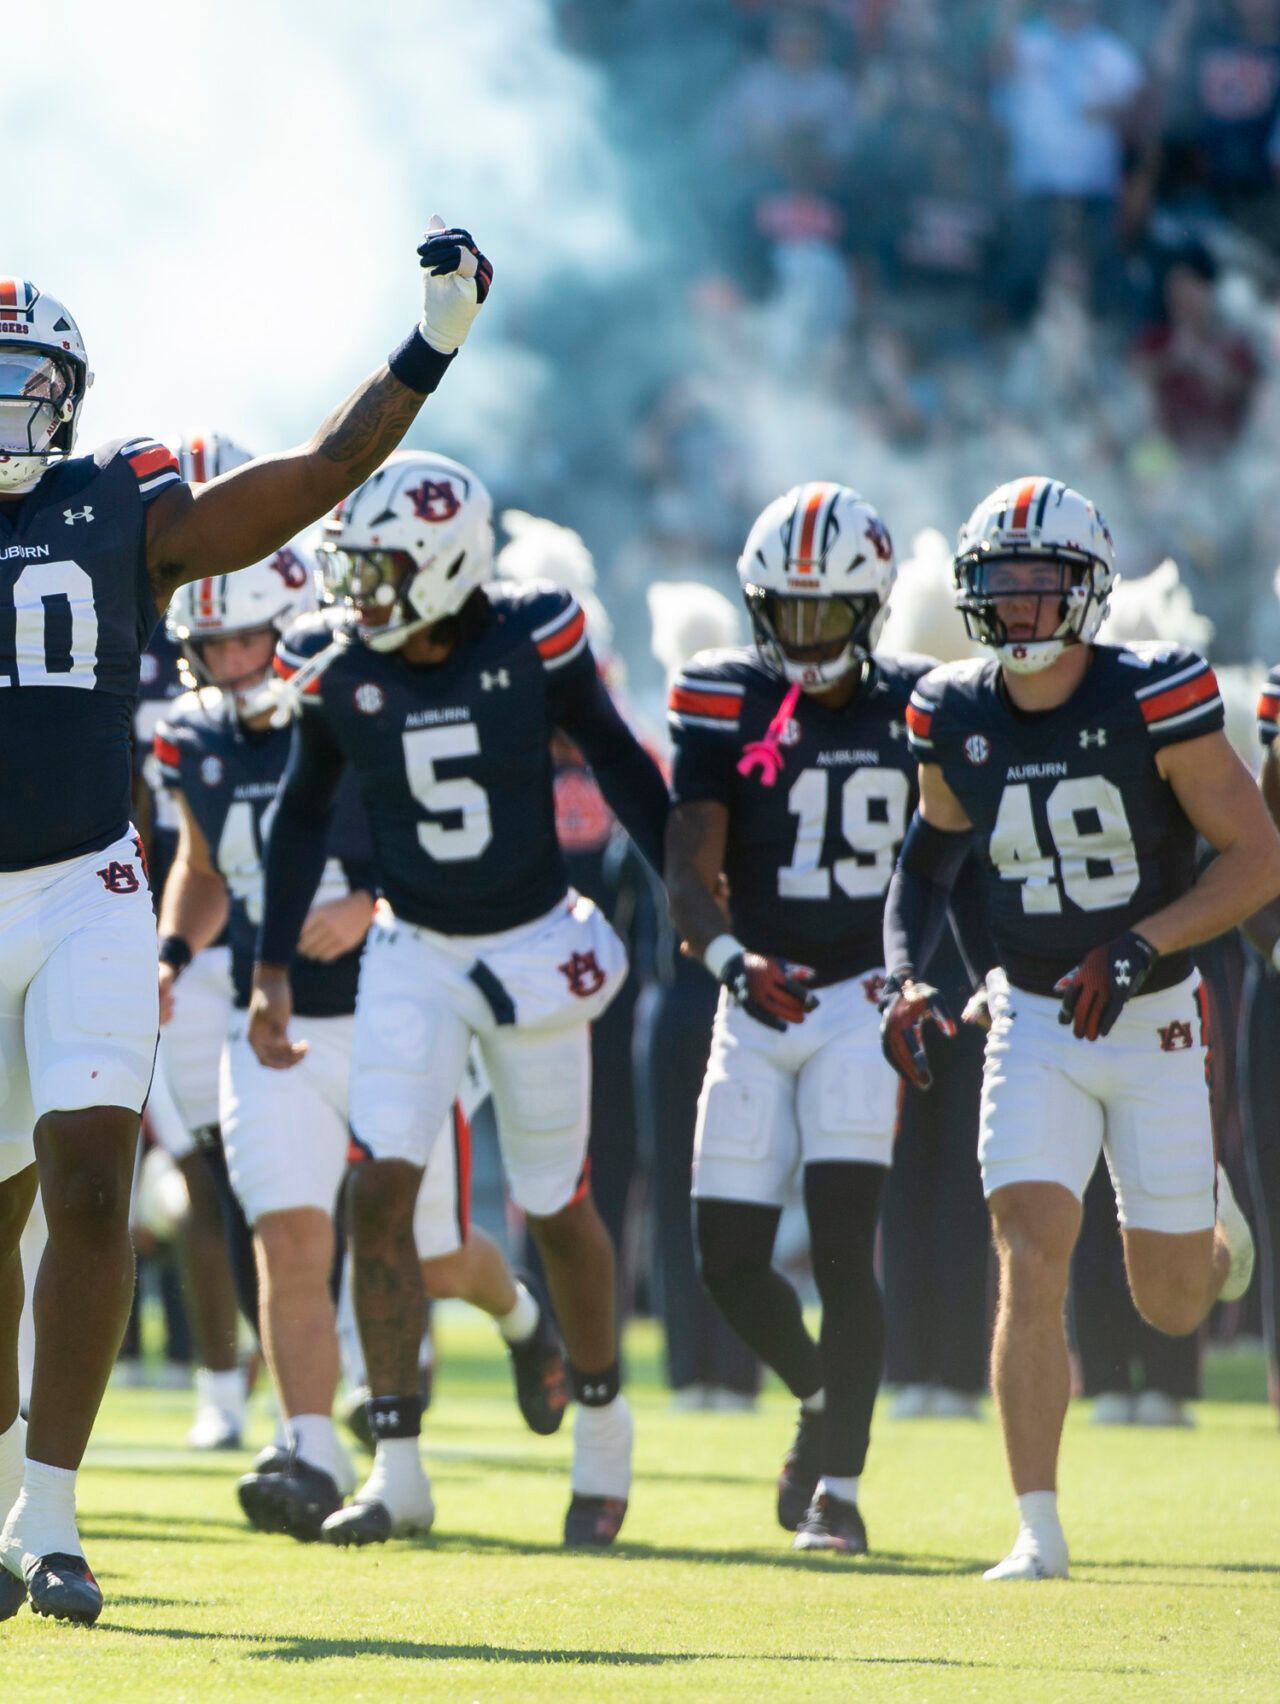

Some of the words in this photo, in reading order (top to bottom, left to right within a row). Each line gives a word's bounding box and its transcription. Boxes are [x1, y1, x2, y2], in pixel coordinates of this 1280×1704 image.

[401, 721, 494, 863] 5
[777, 766, 910, 899] 19
[1006, 762, 1068, 781] AUBURN
[989, 774, 1141, 915] 48
